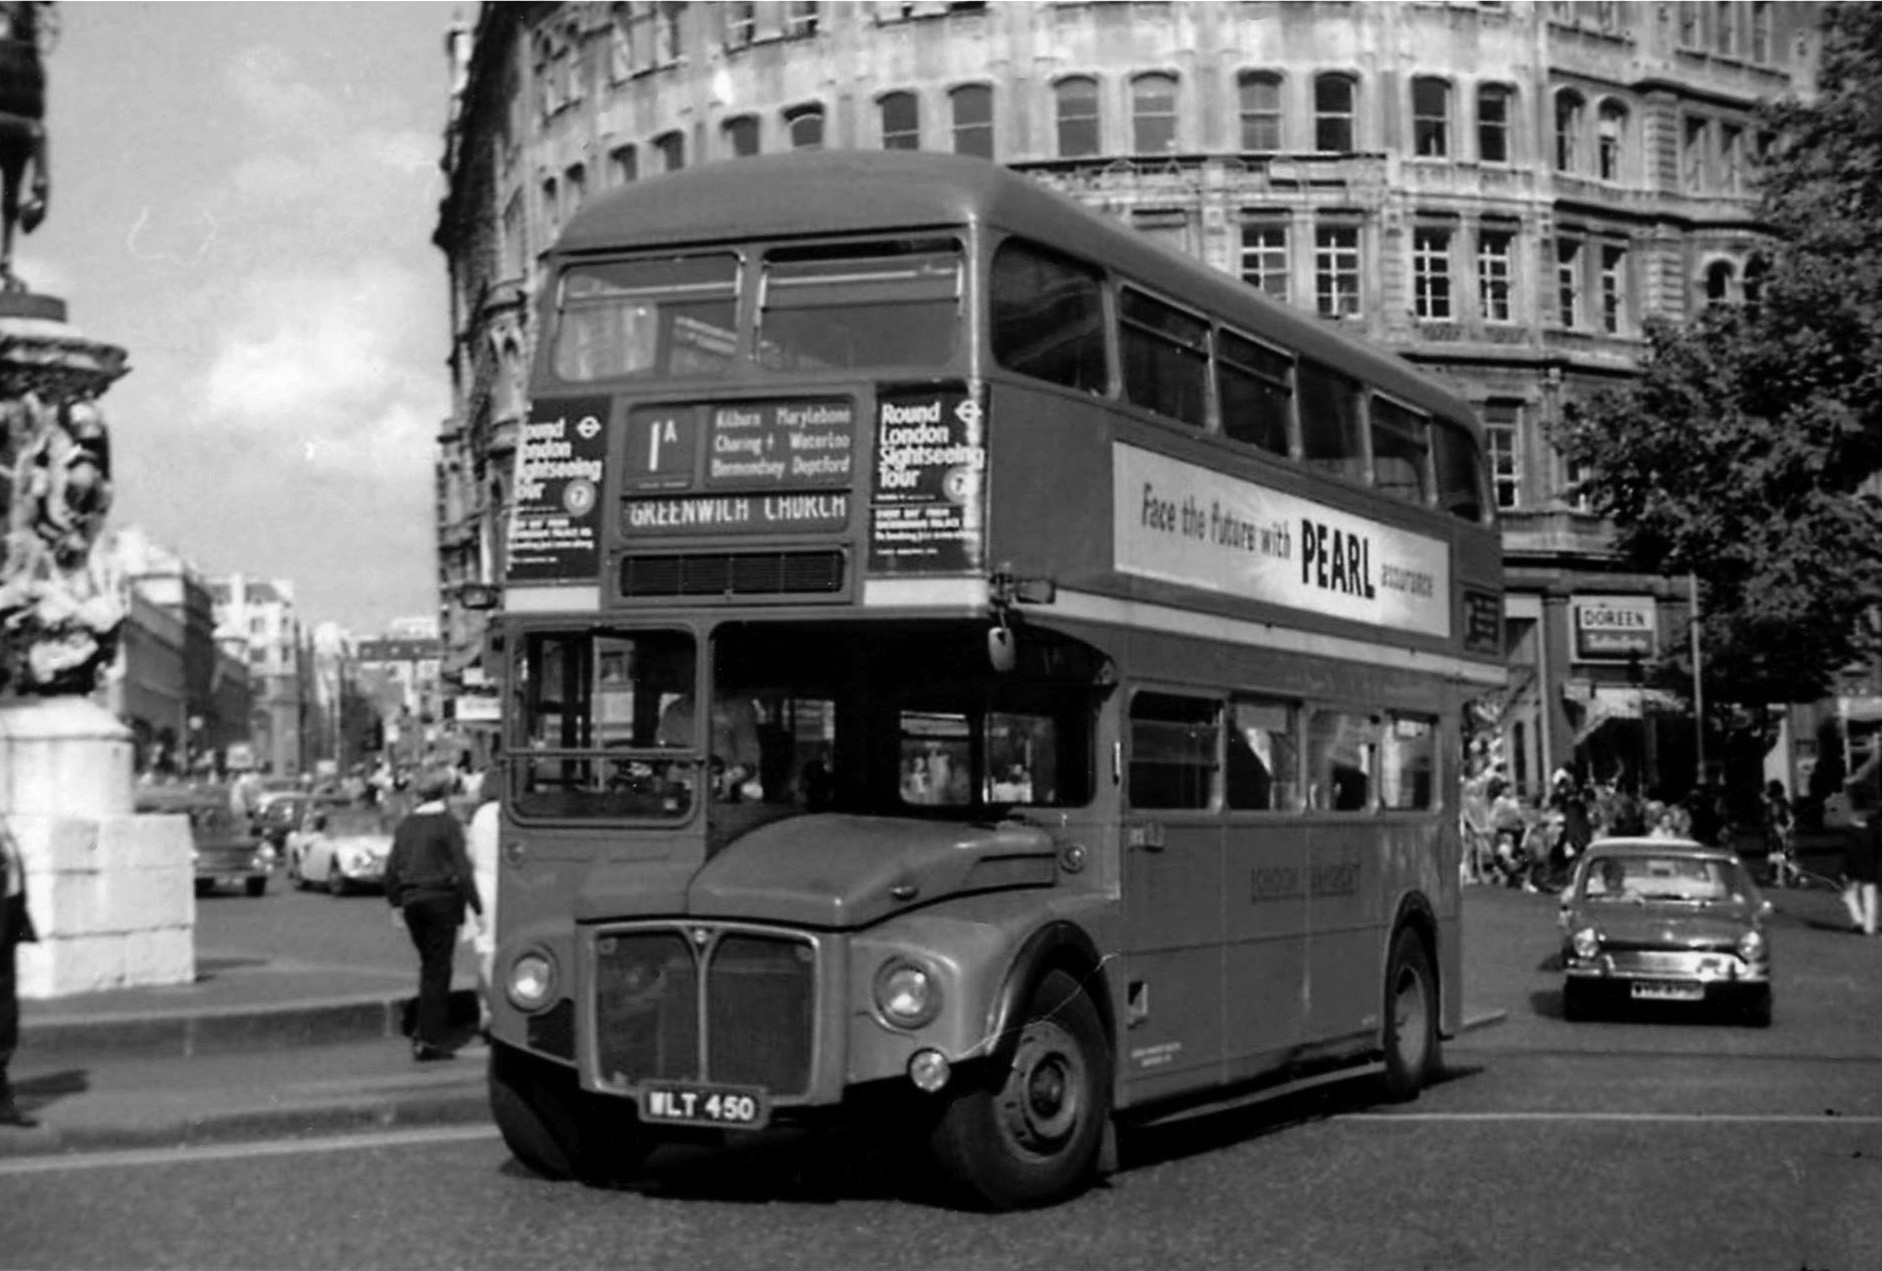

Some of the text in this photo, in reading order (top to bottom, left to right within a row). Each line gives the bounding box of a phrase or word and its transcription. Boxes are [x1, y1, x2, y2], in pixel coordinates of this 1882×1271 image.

[776, 407, 850, 428] Marylebone
[881, 401, 941, 424] Round
[881, 424, 949, 445] London
[880, 442, 984, 470] Sightseeing
[880, 461, 921, 487] Tour
[1142, 482, 1176, 532] Face
[1182, 494, 1205, 540] the
[1260, 520, 1291, 560] with
[1301, 518, 1375, 600] PEARL
[705, 1094, 755, 1120] 450
